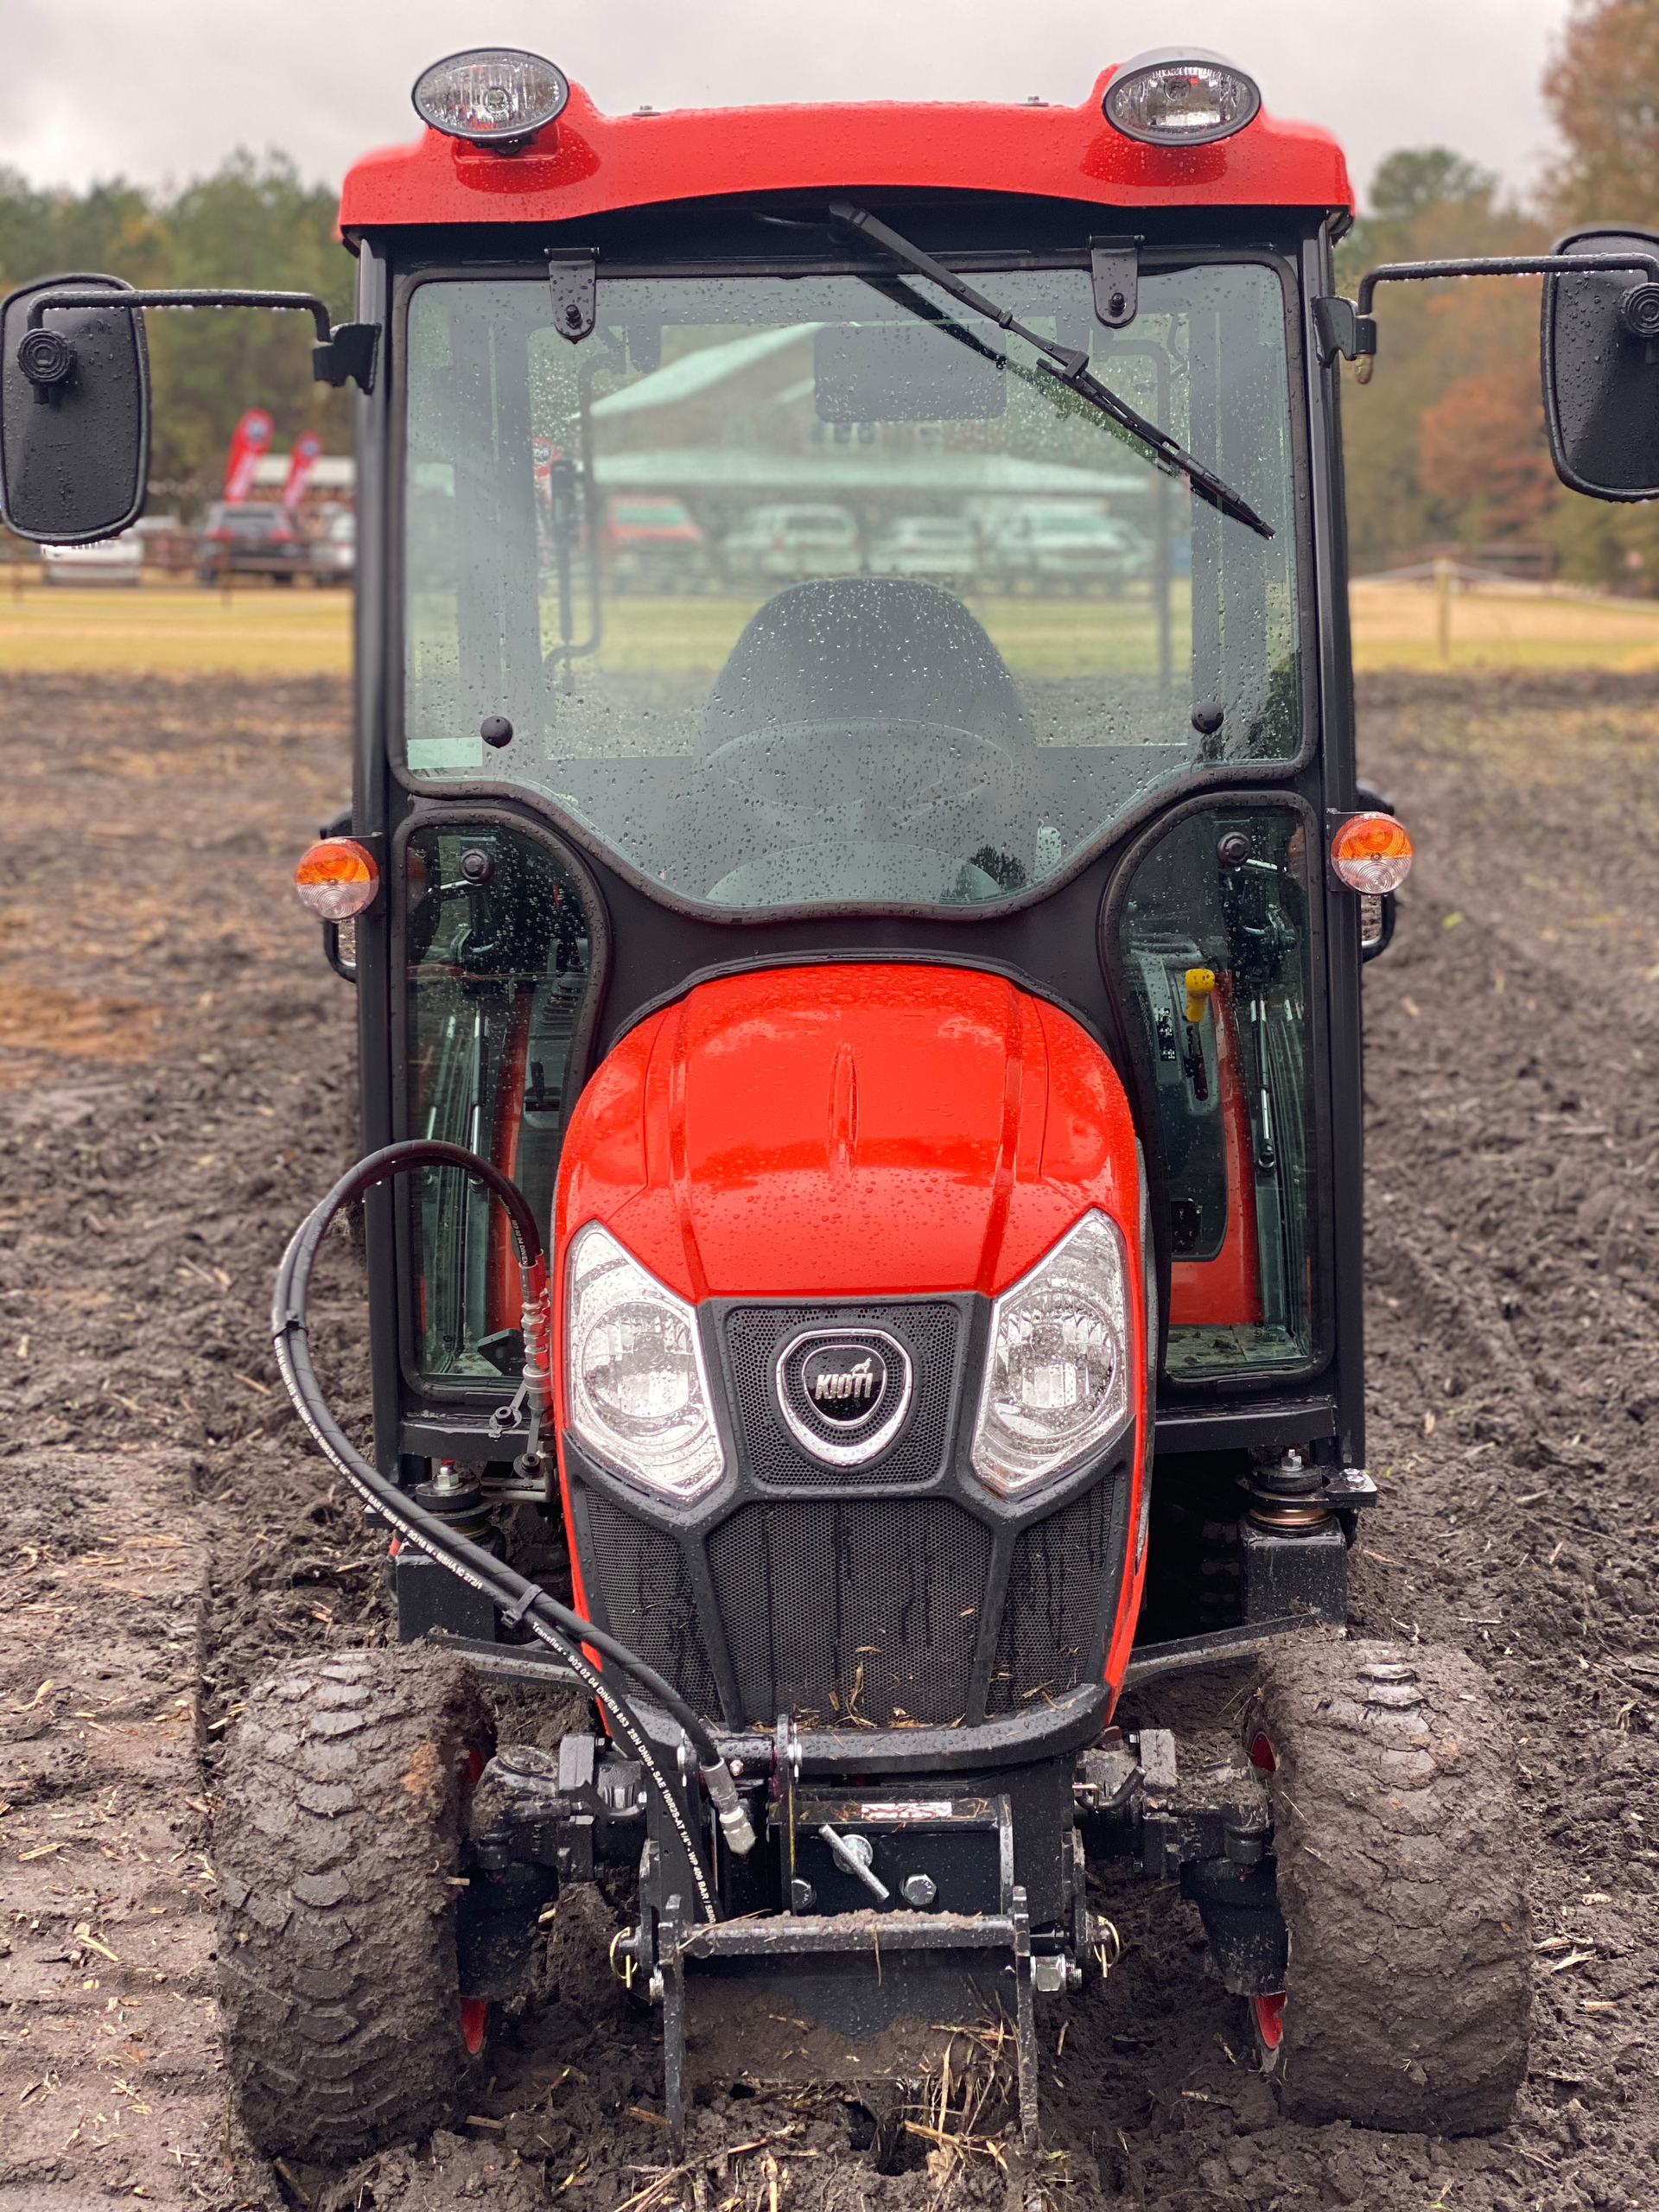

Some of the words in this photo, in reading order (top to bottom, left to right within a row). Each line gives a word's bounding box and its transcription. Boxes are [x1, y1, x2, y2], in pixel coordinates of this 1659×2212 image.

[816, 1372, 874, 1400] KIOTI
[367, 1495, 382, 1510] BAR
[395, 1520, 408, 1533] PSI
[435, 1552, 456, 1572] MSHA
[455, 1567, 465, 1577] IC
[532, 1622, 563, 1653] Transflex
[568, 1655, 582, 1670] 902
[580, 1668, 591, 1679] 02
[588, 1677, 600, 1688] 04
[596, 1687, 620, 1714] DIN/EN
[616, 1713, 630, 1727] 853
[626, 1728, 642, 1745] 2SN
[652, 1770, 666, 1789] SAE
[688, 1851, 699, 1866] WP
[693, 1866, 703, 1880] 400
[697, 1880, 709, 1900] BAR
